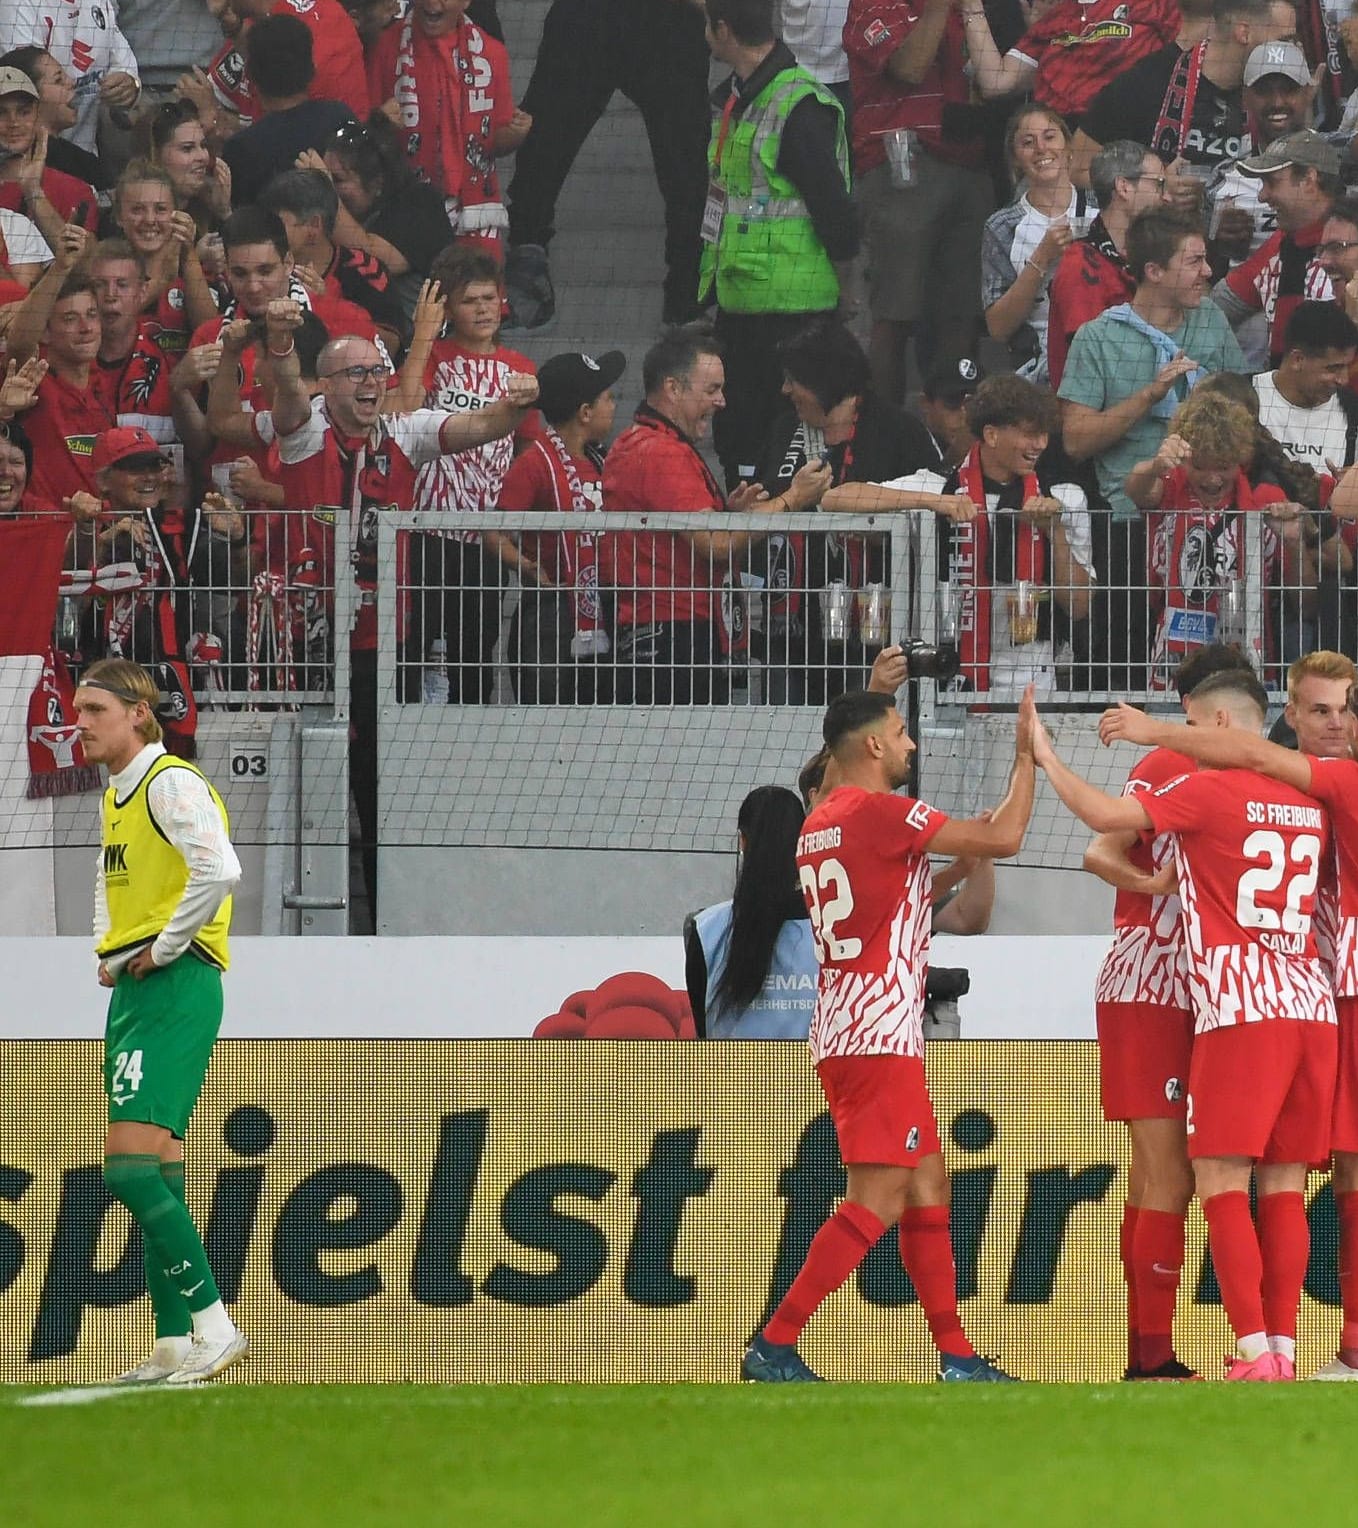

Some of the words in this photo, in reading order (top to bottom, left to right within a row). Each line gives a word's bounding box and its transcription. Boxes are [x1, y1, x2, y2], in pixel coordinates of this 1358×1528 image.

[232, 755, 267, 776] 03
[1246, 801, 1265, 823] SC
[1268, 803, 1322, 829] FREIBUR
[1236, 829, 1321, 935] 22
[800, 858, 862, 964] 32
[112, 1050, 143, 1093] 24
